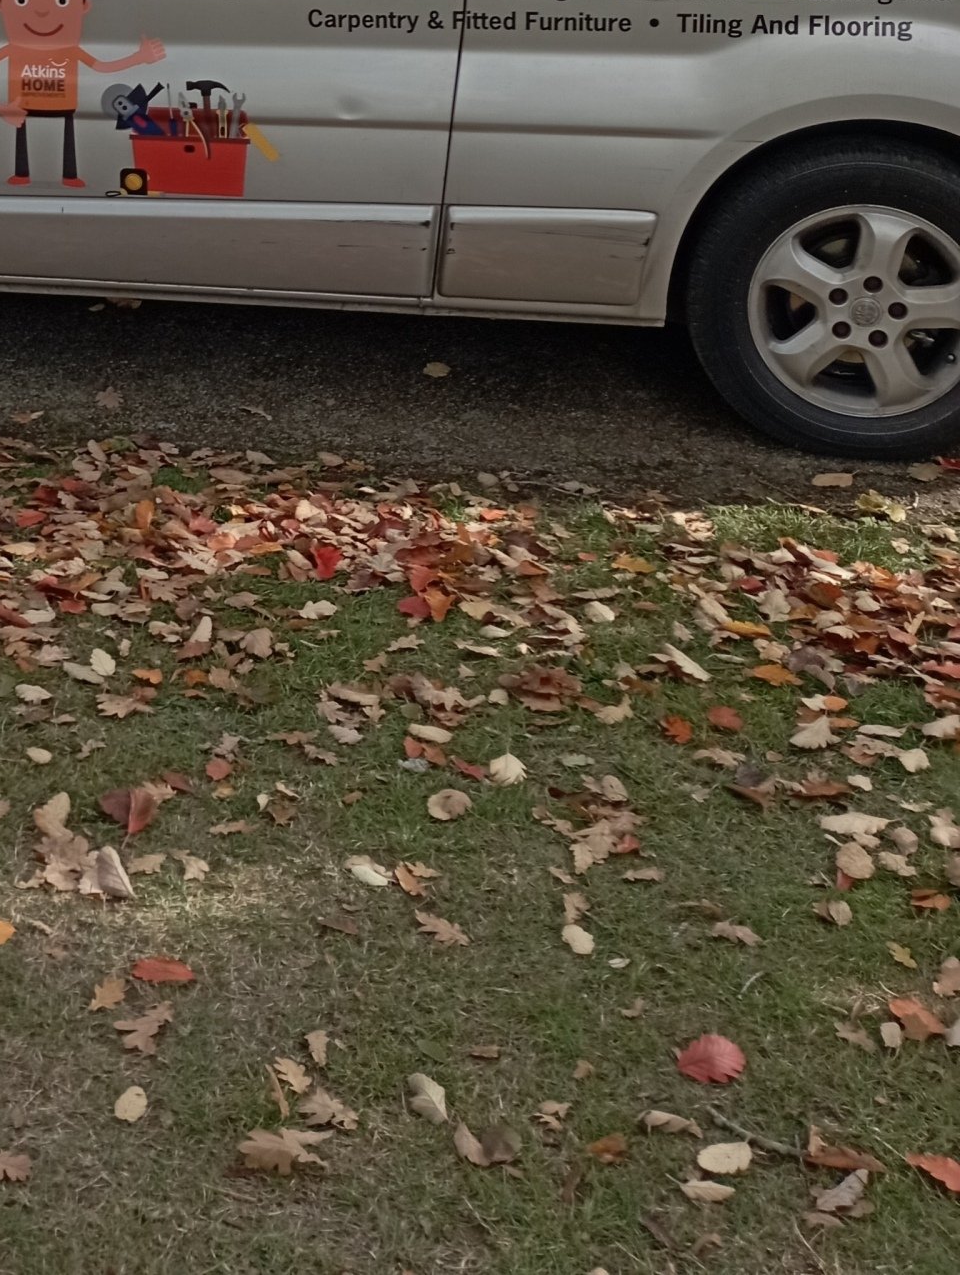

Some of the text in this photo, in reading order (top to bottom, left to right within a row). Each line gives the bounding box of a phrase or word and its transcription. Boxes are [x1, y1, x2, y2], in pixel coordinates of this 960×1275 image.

[307, 9, 913, 41] Carpentry & Fitted Furniture Tiling And Flooring
[21, 64, 66, 79] Atkins
[21, 79, 65, 92] HOME
